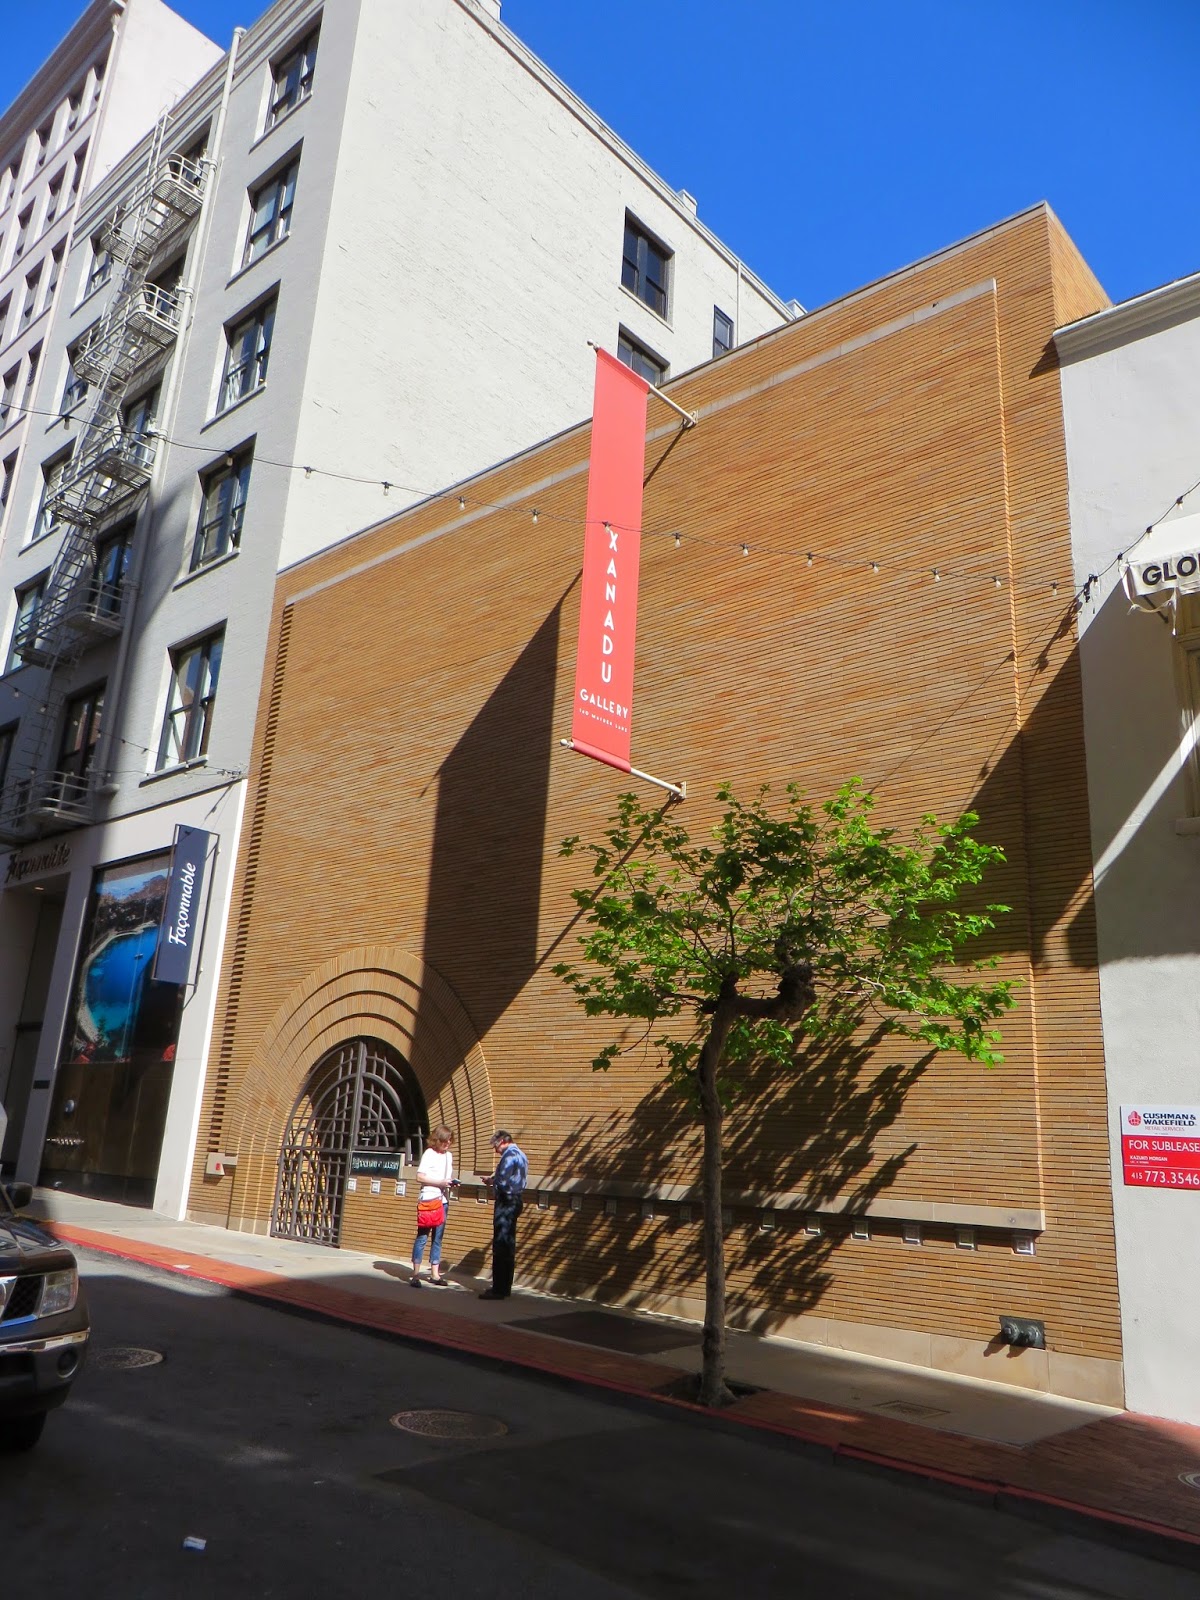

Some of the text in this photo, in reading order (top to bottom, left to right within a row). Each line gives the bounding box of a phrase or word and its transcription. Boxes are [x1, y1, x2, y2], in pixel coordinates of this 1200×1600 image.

[1142, 552, 1200, 586] GLO
[601, 529, 618, 683] XANADU
[580, 688, 628, 719] GALLERY
[168, 862, 197, 947] Façonnable
[1129, 1140, 1200, 1152] FOR SUBLEASE
[1131, 1170, 1200, 1185] 415 773.3546
